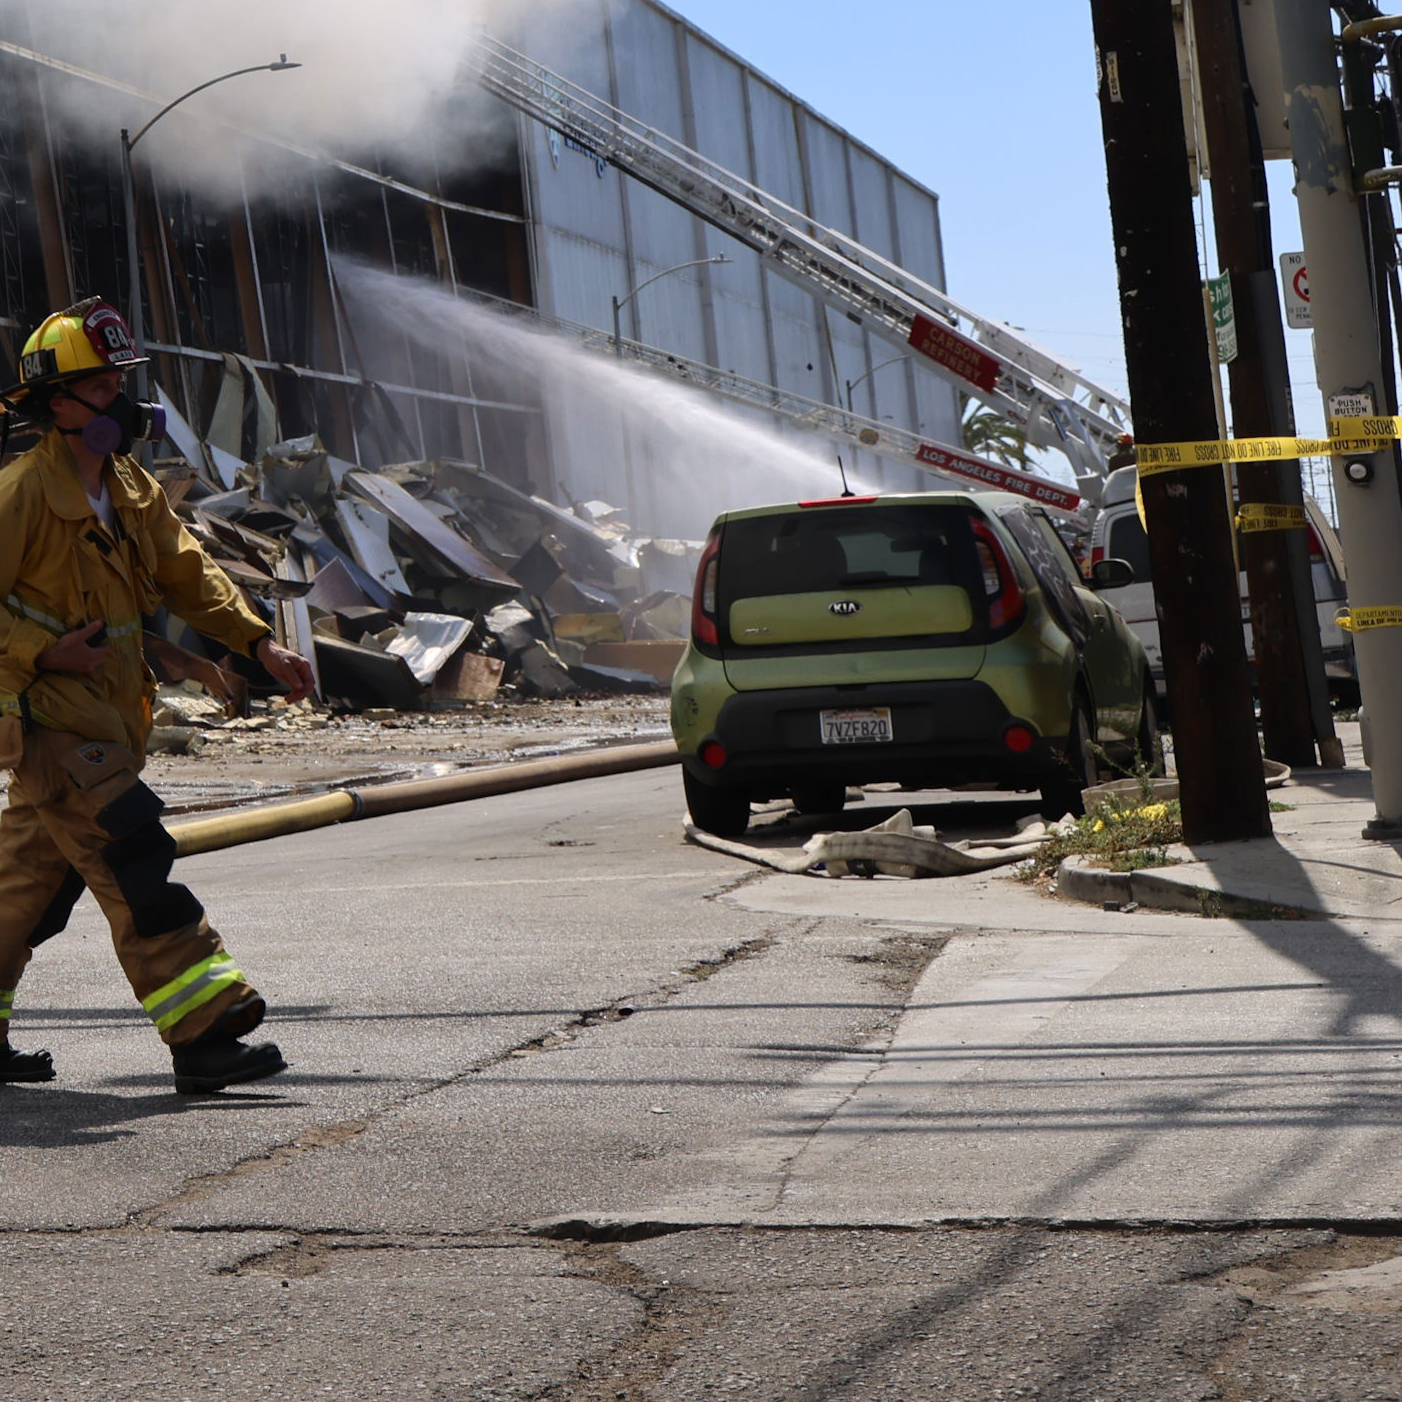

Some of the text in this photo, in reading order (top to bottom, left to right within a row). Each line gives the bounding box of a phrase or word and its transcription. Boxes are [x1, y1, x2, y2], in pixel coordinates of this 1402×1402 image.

[1289, 255, 1301, 265] NO
[104, 325, 129, 349] 84
[929, 326, 981, 366] CARSON
[23, 352, 43, 379] 84
[922, 339, 981, 381] REFINERY
[1334, 406, 1367, 415] BUTTON
[1338, 399, 1361, 407] PUSH
[1362, 419, 1398, 436] CROSS
[1163, 446, 1181, 462] FIRE
[1194, 445, 1219, 461] CROSS
[1221, 444, 1235, 459] NOT
[1237, 443, 1247, 459] DO
[1248, 441, 1265, 457] LINE
[1265, 440, 1282, 457] FIRE
[923, 449, 1068, 506] LOS ANGELES FIRE DEPT.
[833, 602, 856, 614] KIA
[827, 719, 887, 738] 7VZF820
